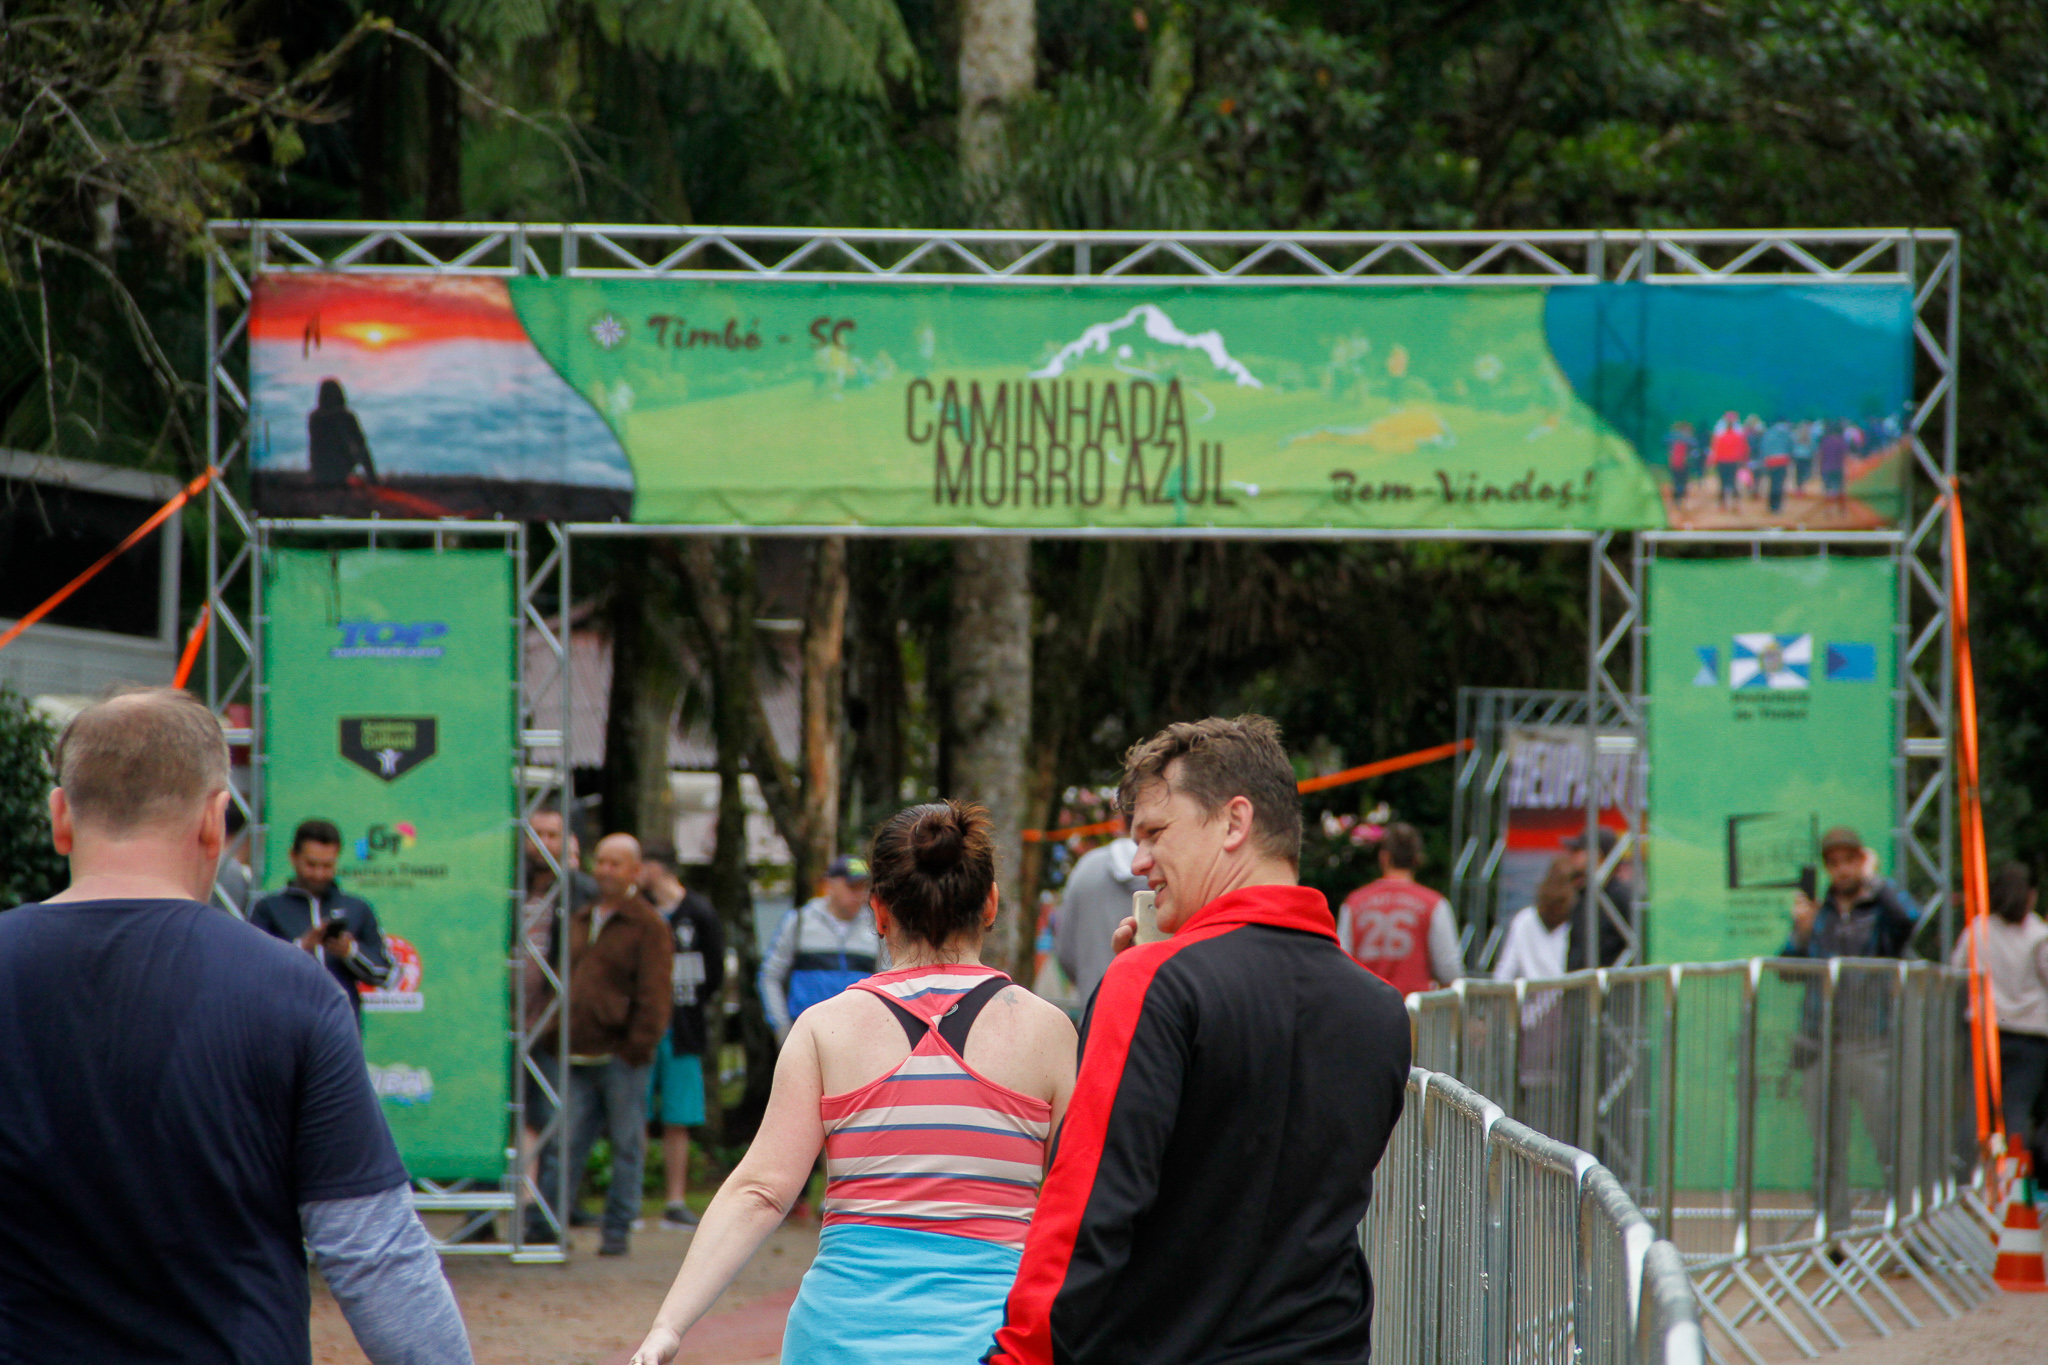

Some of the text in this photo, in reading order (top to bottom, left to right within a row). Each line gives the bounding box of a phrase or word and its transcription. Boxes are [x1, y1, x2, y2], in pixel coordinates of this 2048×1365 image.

[809, 316, 855, 348] SC
[905, 377, 1187, 445] CAMINHADA
[934, 440, 1237, 508] MORRO AZUL
[337, 619, 450, 648] TOP
[1356, 909, 1418, 962] 26
